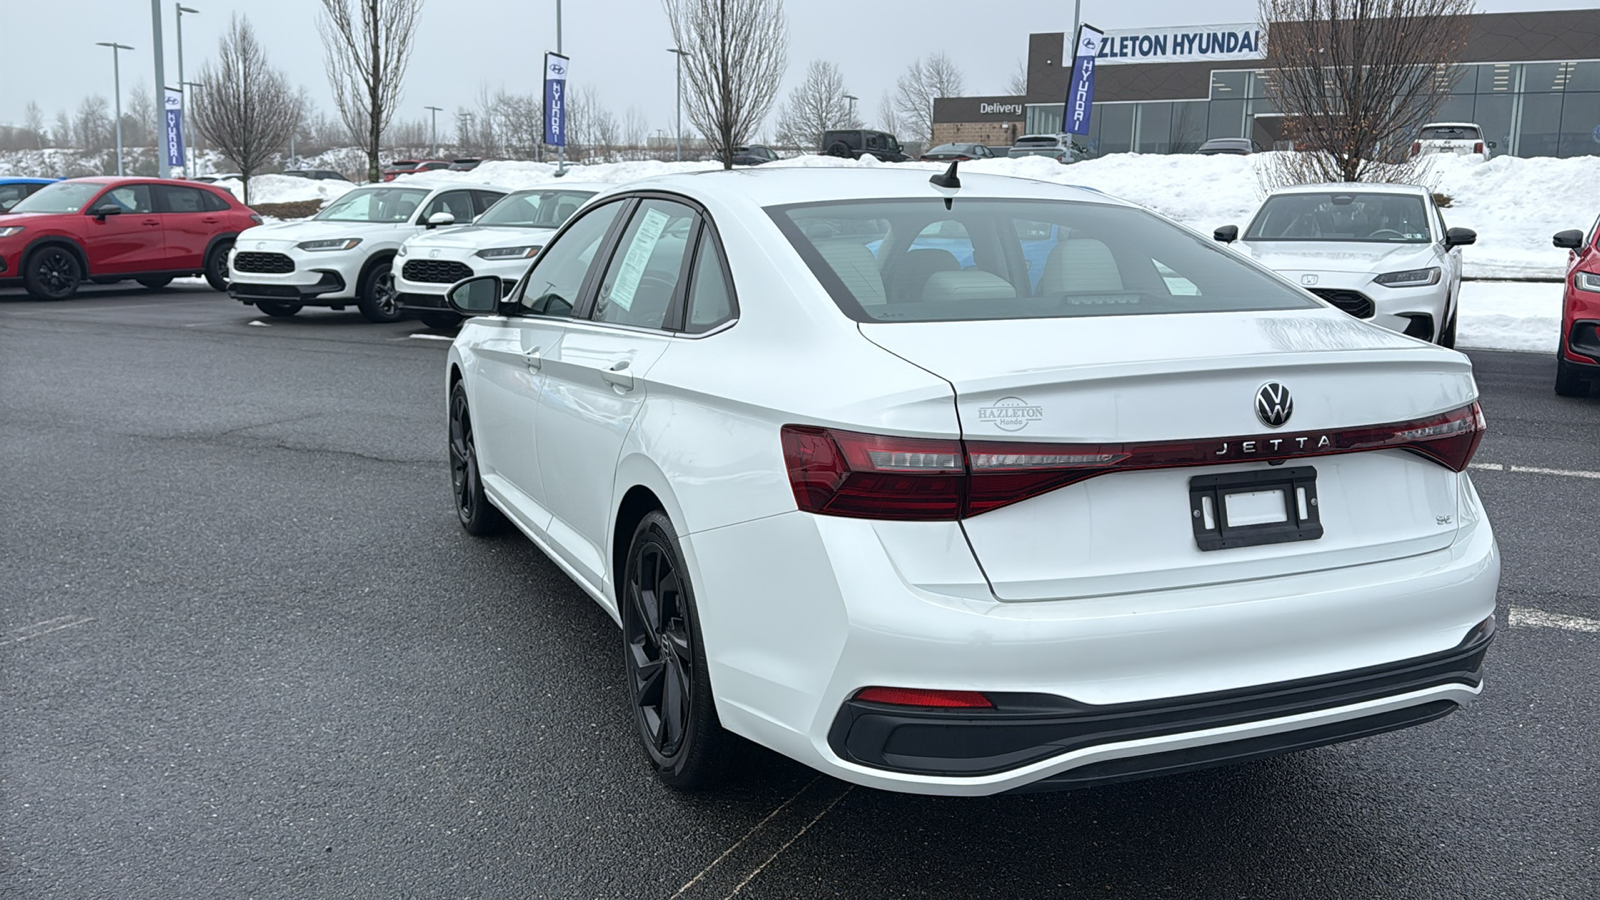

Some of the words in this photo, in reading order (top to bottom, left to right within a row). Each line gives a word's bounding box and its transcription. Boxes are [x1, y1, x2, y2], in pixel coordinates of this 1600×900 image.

[1096, 34, 1168, 58] ZLETON
[1172, 30, 1260, 55] HYUNDAI
[980, 102, 1022, 115] Delivery
[1074, 60, 1093, 131] HYUNDAI
[551, 82, 561, 143] HYUNDAI
[168, 112, 178, 164] HYUNDAI
[978, 408, 1043, 419] HAZLETON
[1216, 435, 1331, 455] JETTA
